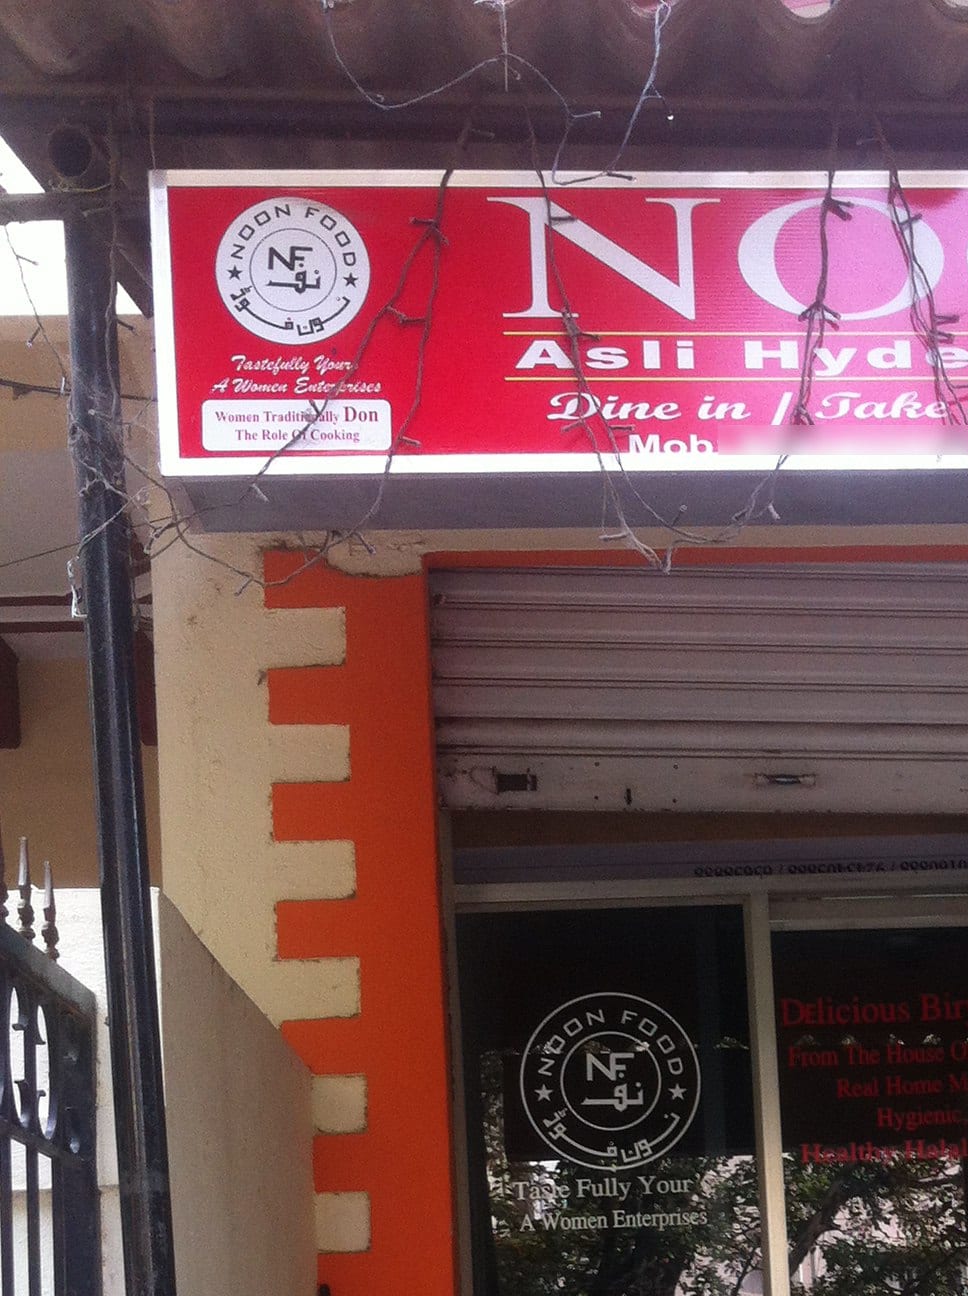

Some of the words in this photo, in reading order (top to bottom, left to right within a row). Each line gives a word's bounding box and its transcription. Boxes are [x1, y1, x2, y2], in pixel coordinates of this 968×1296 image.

[231, 204, 291, 259] NOON
[305, 206, 357, 267] FOOD
[231, 355, 310, 376] Tastefully
[515, 338, 696, 370] Asli
[211, 378, 230, 394] A
[232, 378, 289, 394] Women
[215, 411, 260, 423] Women
[344, 406, 379, 423] Don
[547, 392, 682, 423] Dine
[698, 396, 751, 420] in
[815, 393, 947, 420] Take
[235, 429, 258, 441] The
[262, 429, 288, 441] Role
[310, 429, 361, 444] Cooking
[538, 1009, 605, 1076] NOON
[621, 1010, 683, 1075] FOOD
[788, 1046, 838, 1068] From
[848, 1045, 880, 1066] The
[887, 1045, 944, 1065] House
[837, 1078, 879, 1099] Real
[886, 1076, 943, 1097] Home
[513, 1181, 570, 1200] Taste
[576, 1178, 632, 1200] Fully
[637, 1175, 694, 1195] Your
[520, 1215, 536, 1232] A
[543, 1212, 608, 1230] Women
[612, 1210, 708, 1229] Enterprises
